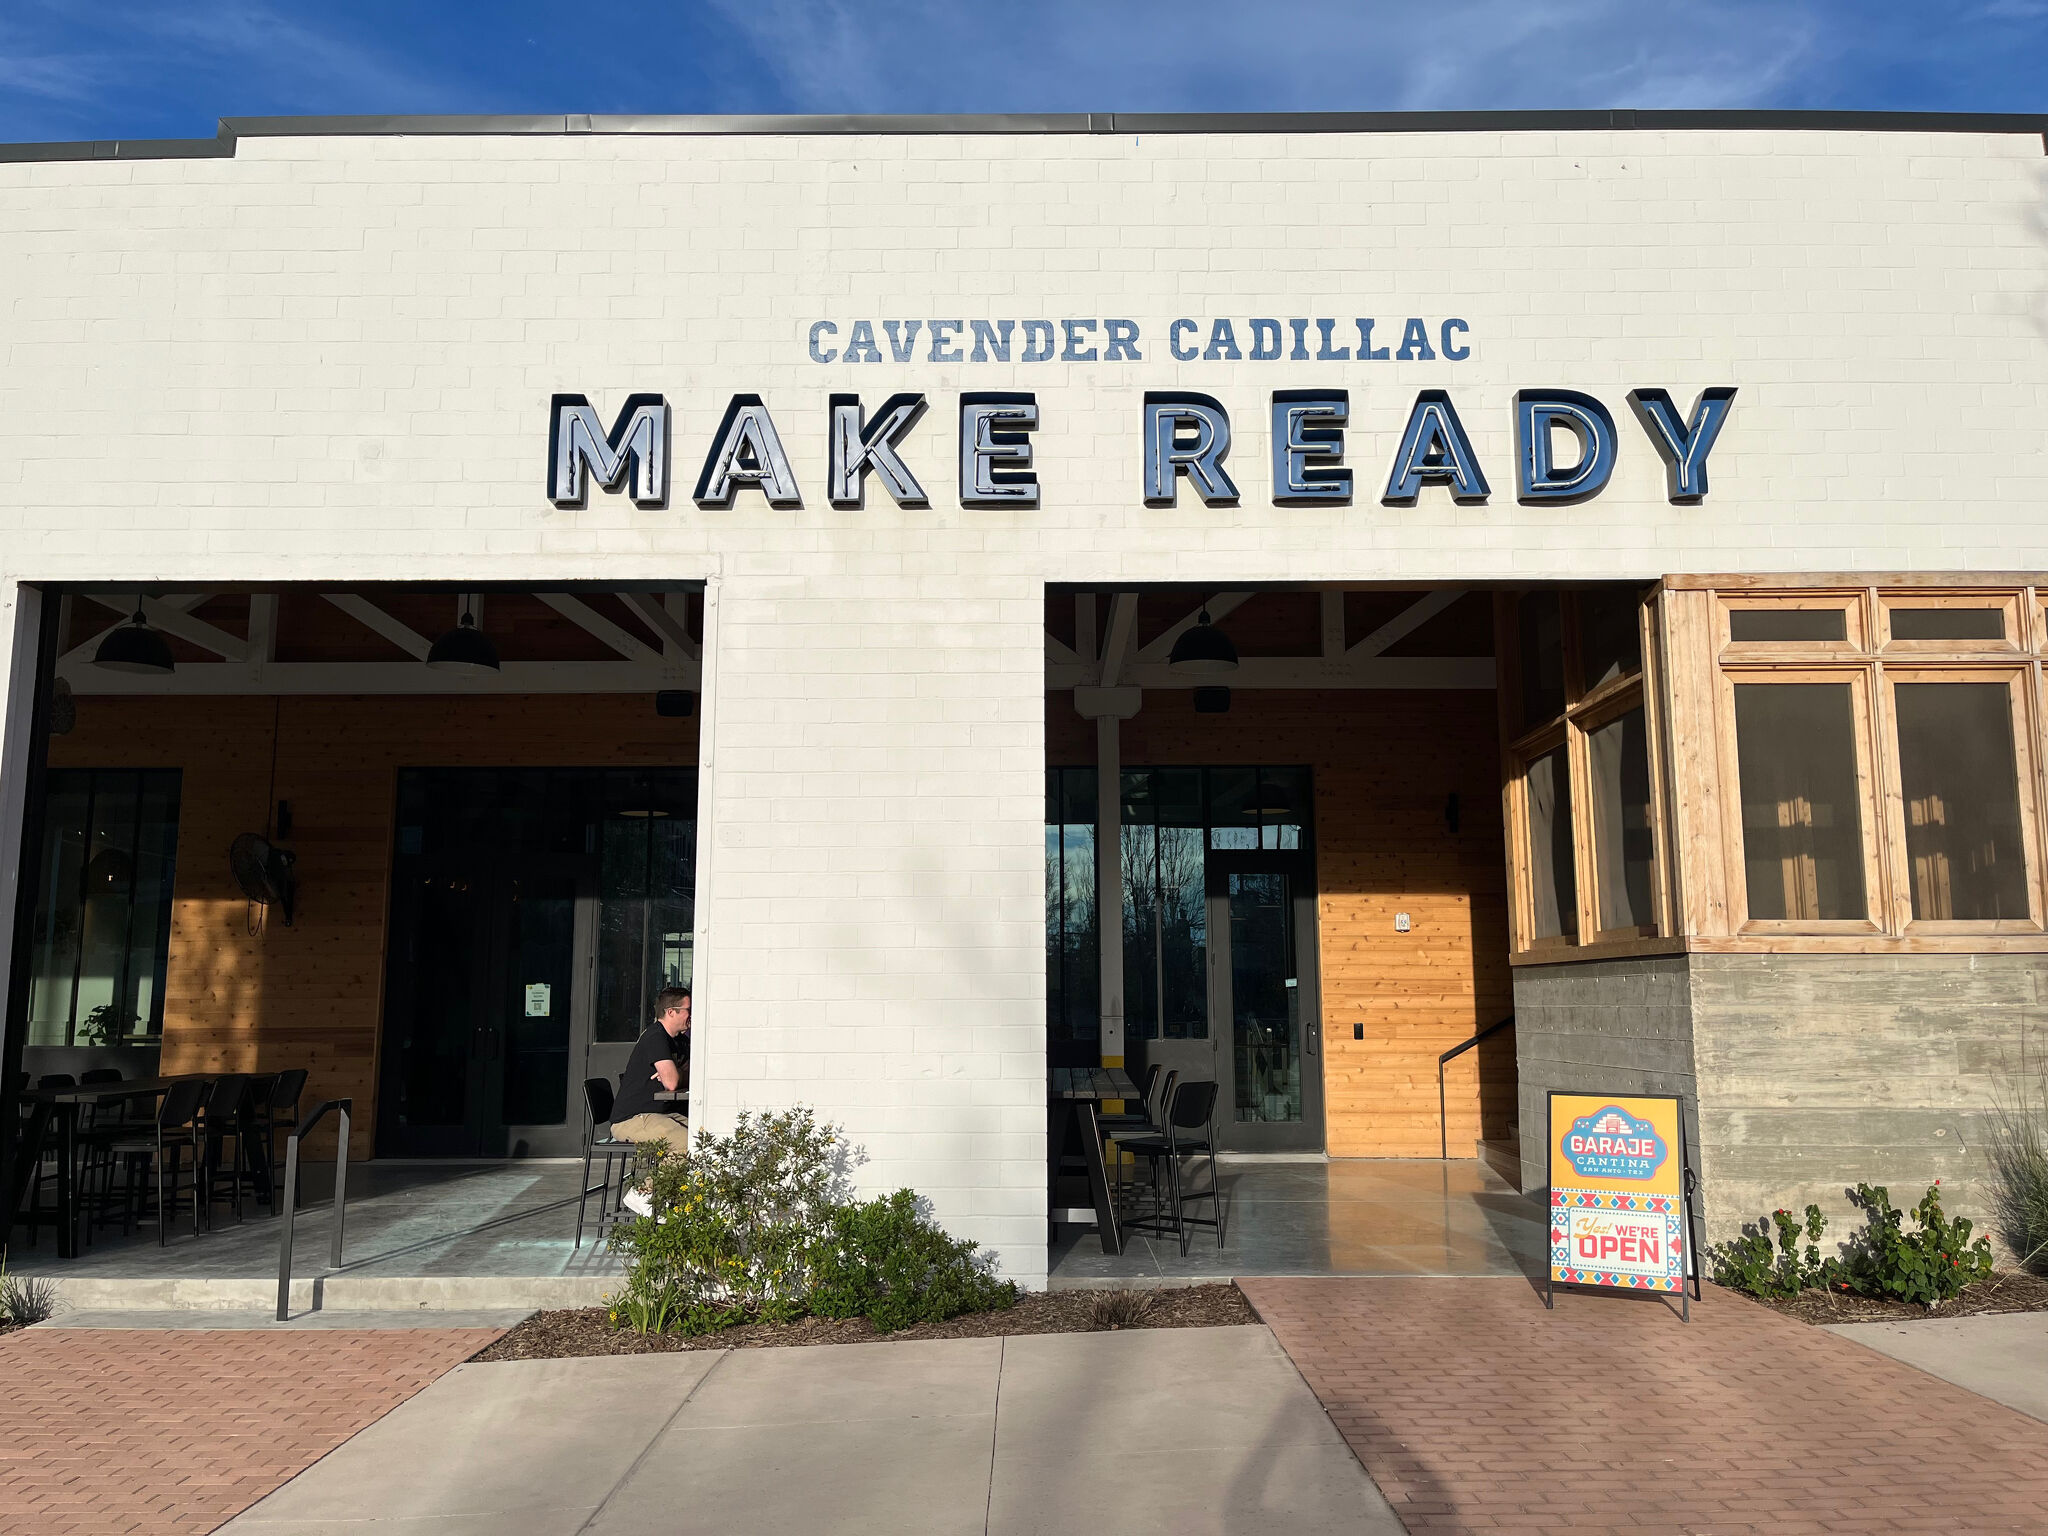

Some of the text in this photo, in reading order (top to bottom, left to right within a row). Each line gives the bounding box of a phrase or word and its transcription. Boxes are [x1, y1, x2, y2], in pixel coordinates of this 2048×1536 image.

[808, 318, 1471, 363] CAVENDER CADILLAC
[547, 387, 1739, 511] MAKE READY
[1570, 1135, 1656, 1157] GARAJE
[1576, 1156, 1650, 1169] CANTINA
[1573, 1217, 1659, 1239] Yes! WE'RE
[1579, 1235, 1659, 1264] OPEN
